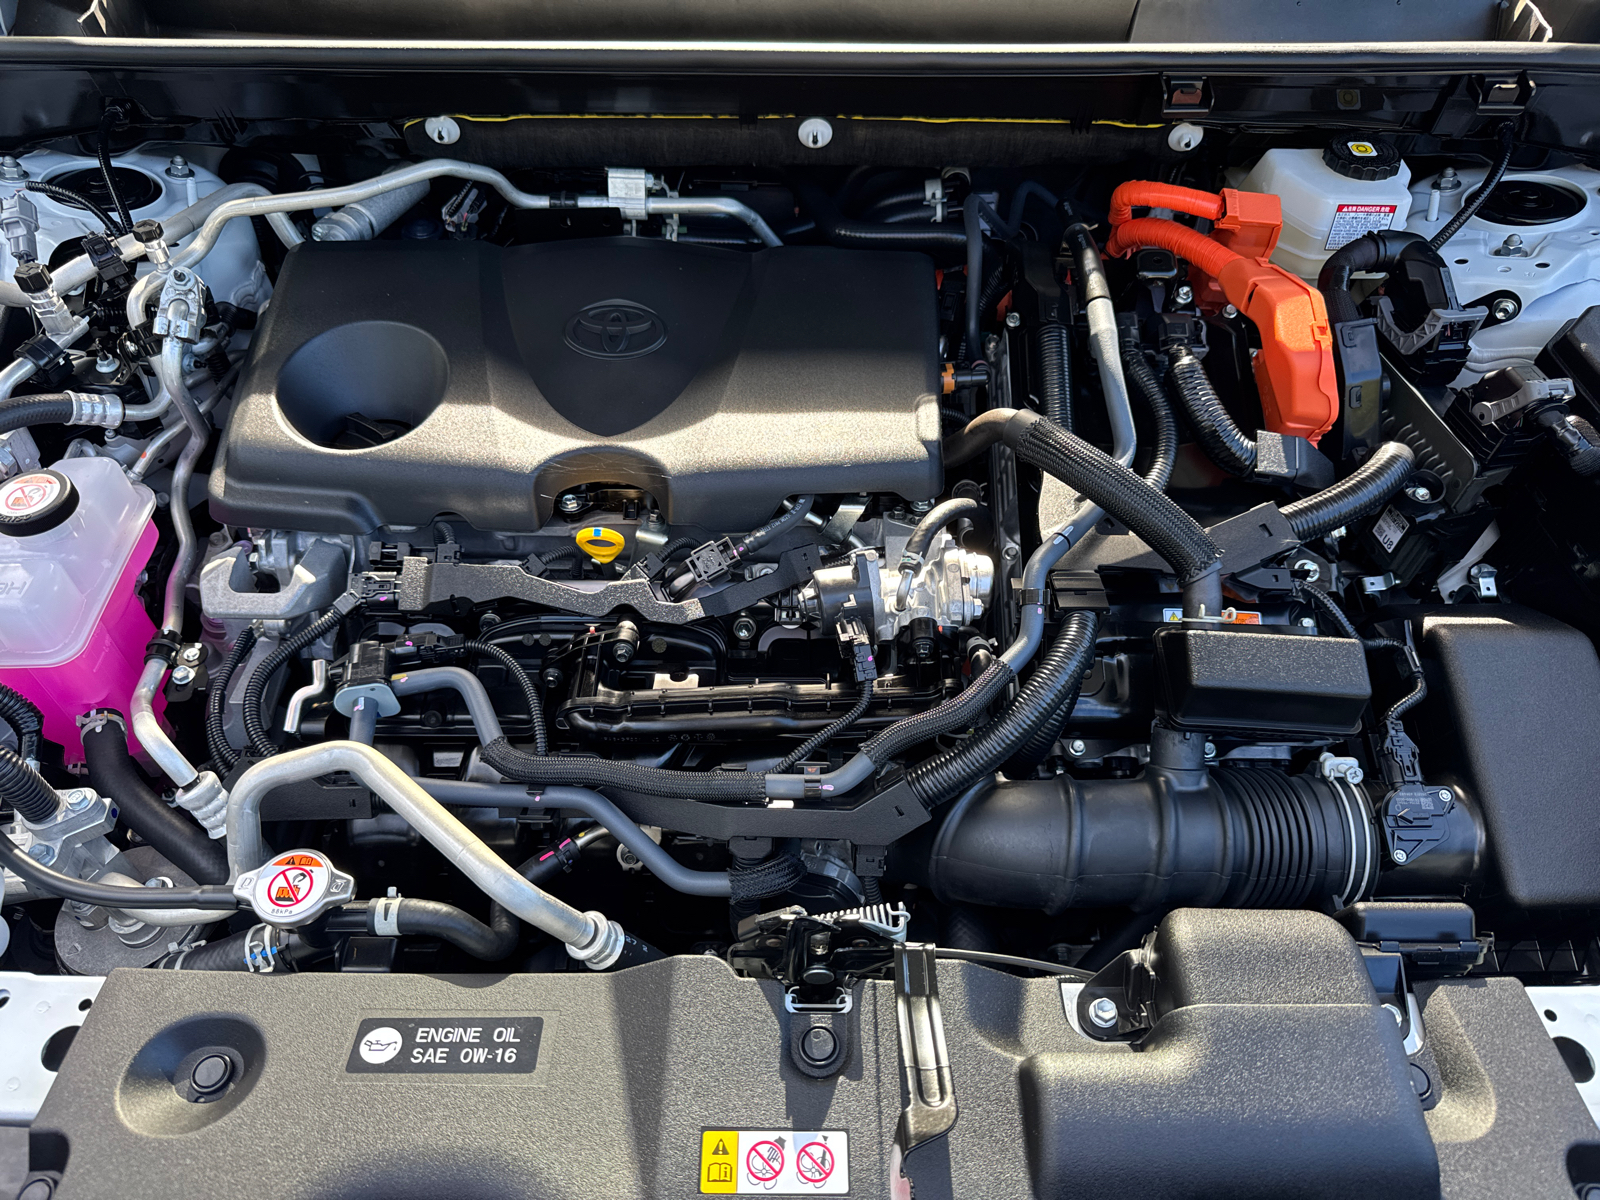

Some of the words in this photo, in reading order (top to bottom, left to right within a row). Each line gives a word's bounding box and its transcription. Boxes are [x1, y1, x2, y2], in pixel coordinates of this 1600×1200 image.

[1382, 534, 1394, 550] U8
[415, 1027, 482, 1043] ENGINE
[493, 1027, 521, 1043] OIL
[410, 1047, 450, 1064] SAE
[459, 1047, 517, 1064] 0W-16
